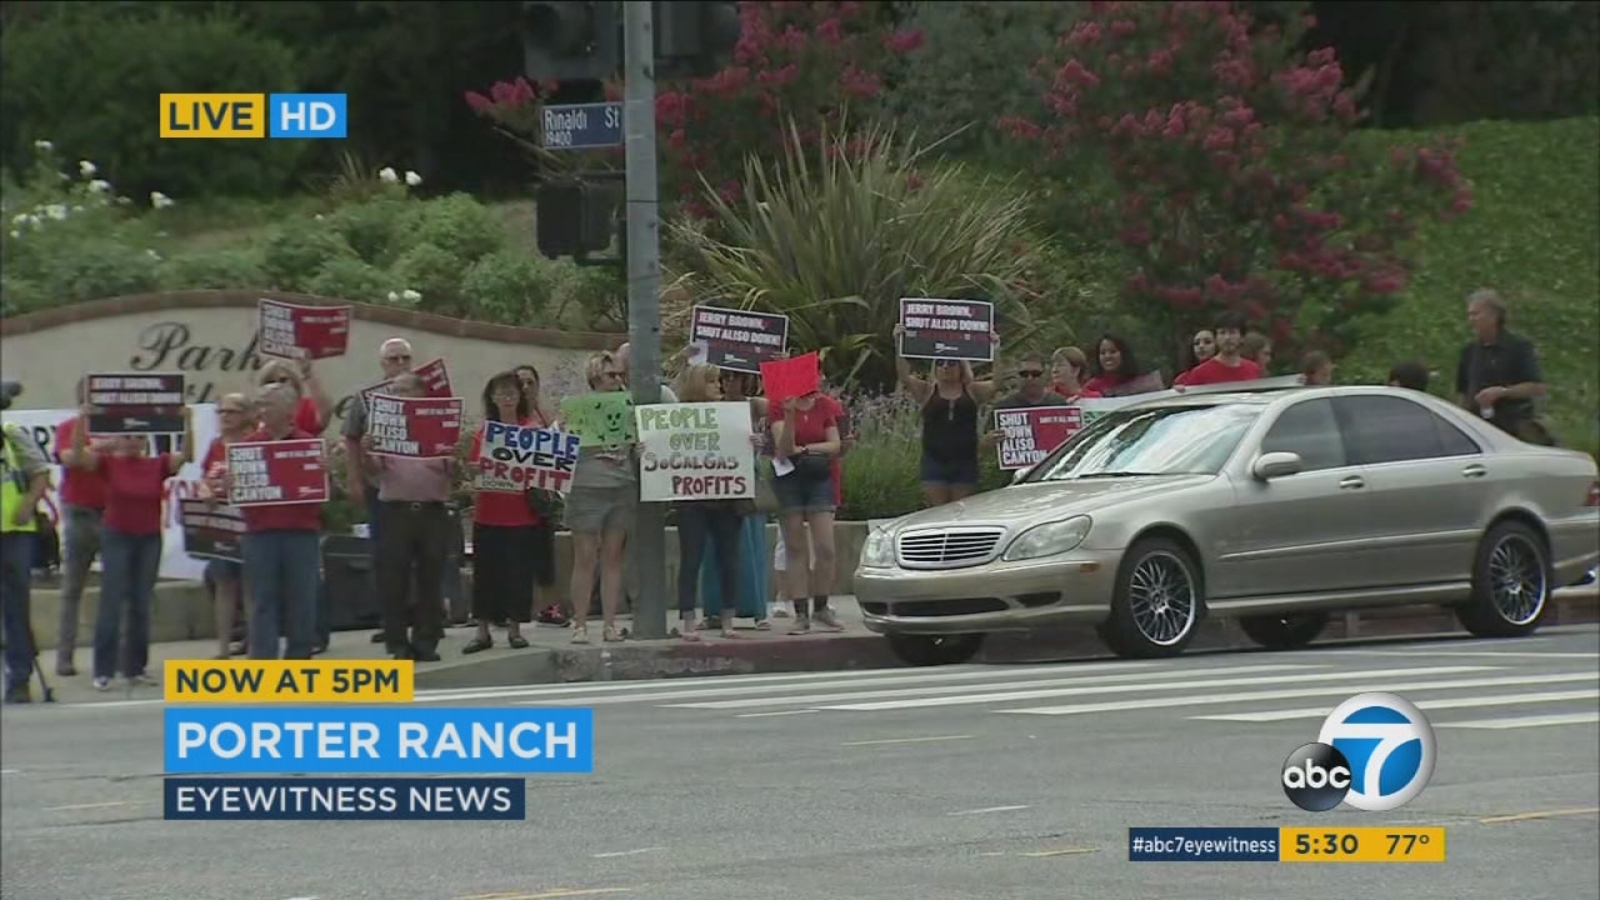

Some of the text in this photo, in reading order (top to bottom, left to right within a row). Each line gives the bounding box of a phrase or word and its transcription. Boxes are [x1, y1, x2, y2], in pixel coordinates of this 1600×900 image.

[544, 106, 620, 131] Rinaldi St
[697, 311, 727, 325] JERRY
[906, 303, 934, 315] JERRY
[696, 325, 721, 339] SHUT
[721, 329, 750, 342] ALISO
[905, 317, 930, 329] SHUT
[930, 318, 958, 330] ALISO
[130, 321, 261, 371] Park
[374, 400, 405, 414] SHUT
[640, 407, 719, 431] PEOPLE
[1000, 413, 1028, 425] SHUT
[486, 422, 581, 460] PEOPLE
[669, 431, 721, 452] OVER
[1003, 438, 1035, 452] ALISO
[492, 447, 575, 472] OVER
[480, 457, 572, 491] PROFIT
[671, 475, 747, 496] PROFITS
